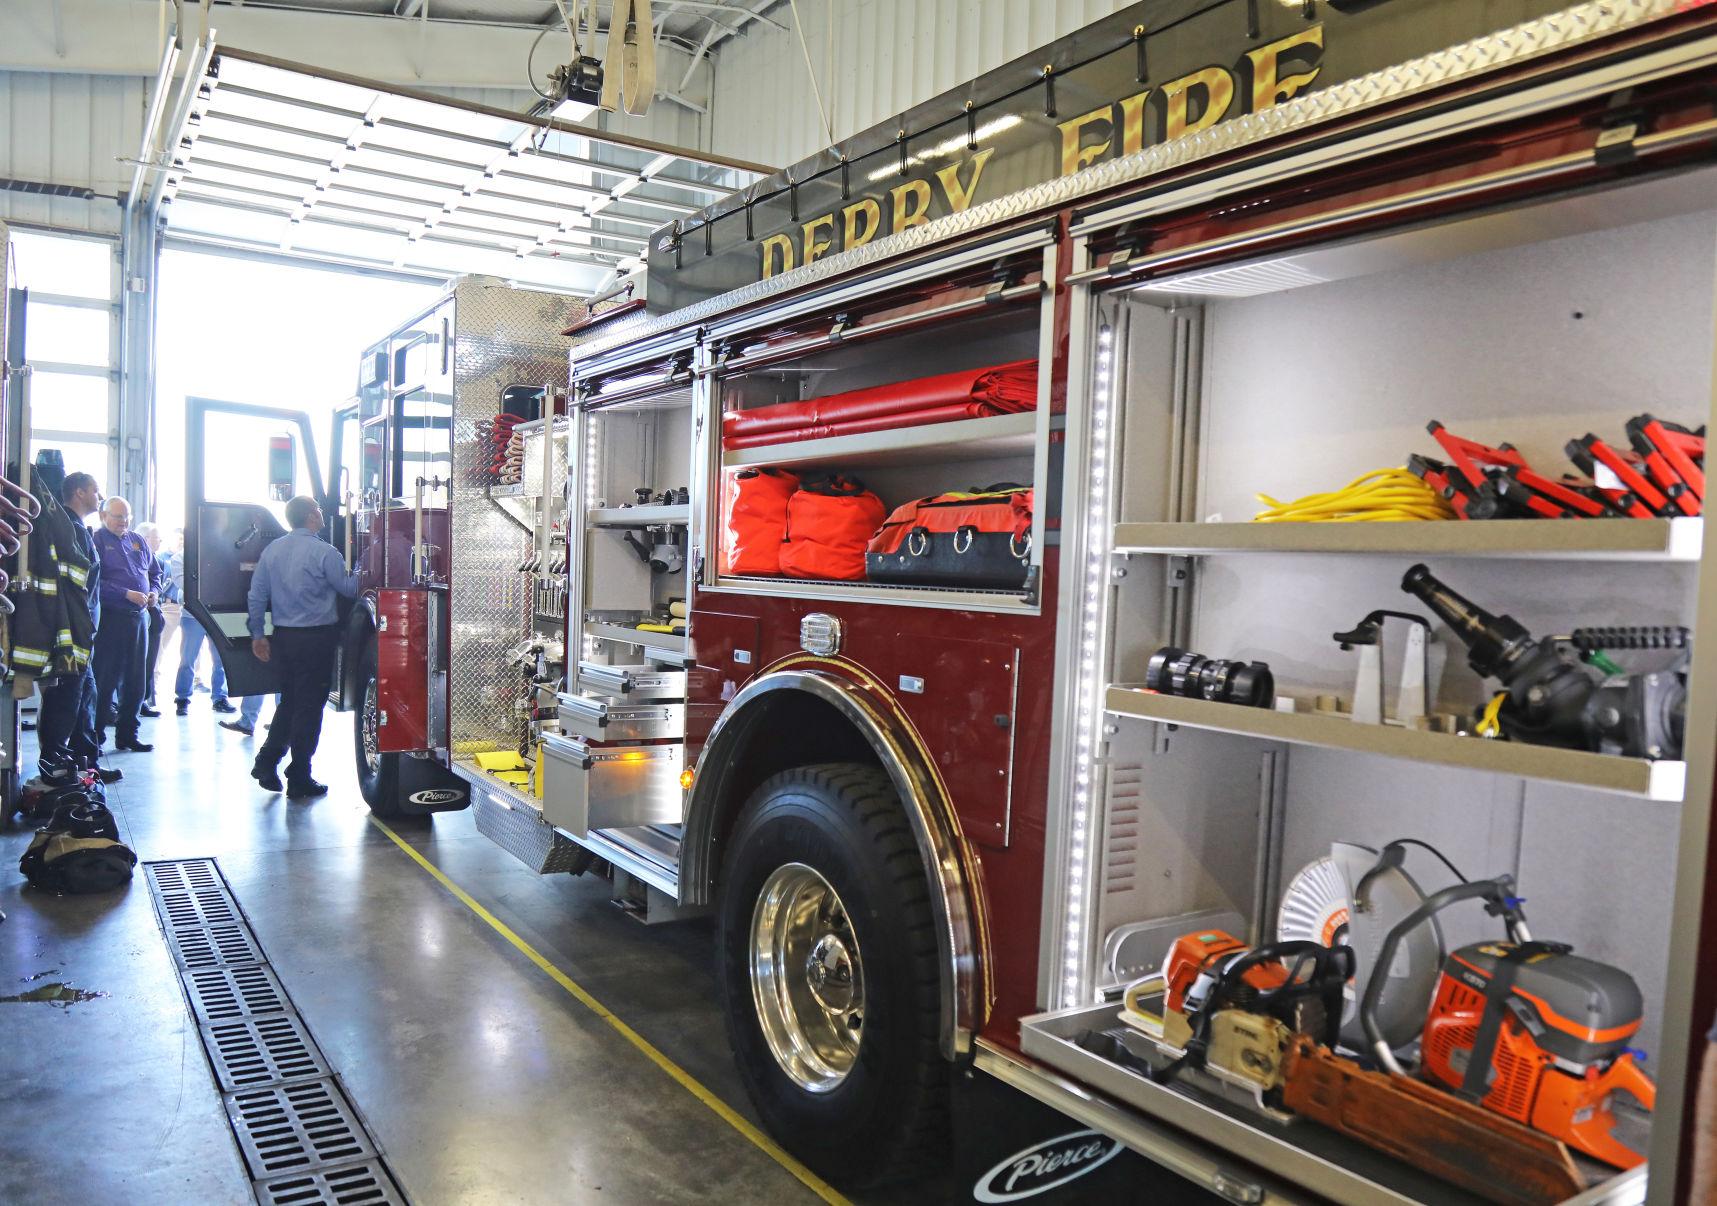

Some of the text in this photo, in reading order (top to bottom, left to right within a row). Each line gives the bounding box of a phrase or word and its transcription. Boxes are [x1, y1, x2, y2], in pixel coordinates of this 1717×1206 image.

[761, 24, 1323, 281] DERRY FIRE
[421, 790, 453, 802] Pierce
[1005, 1141, 1103, 1192] Pierce
